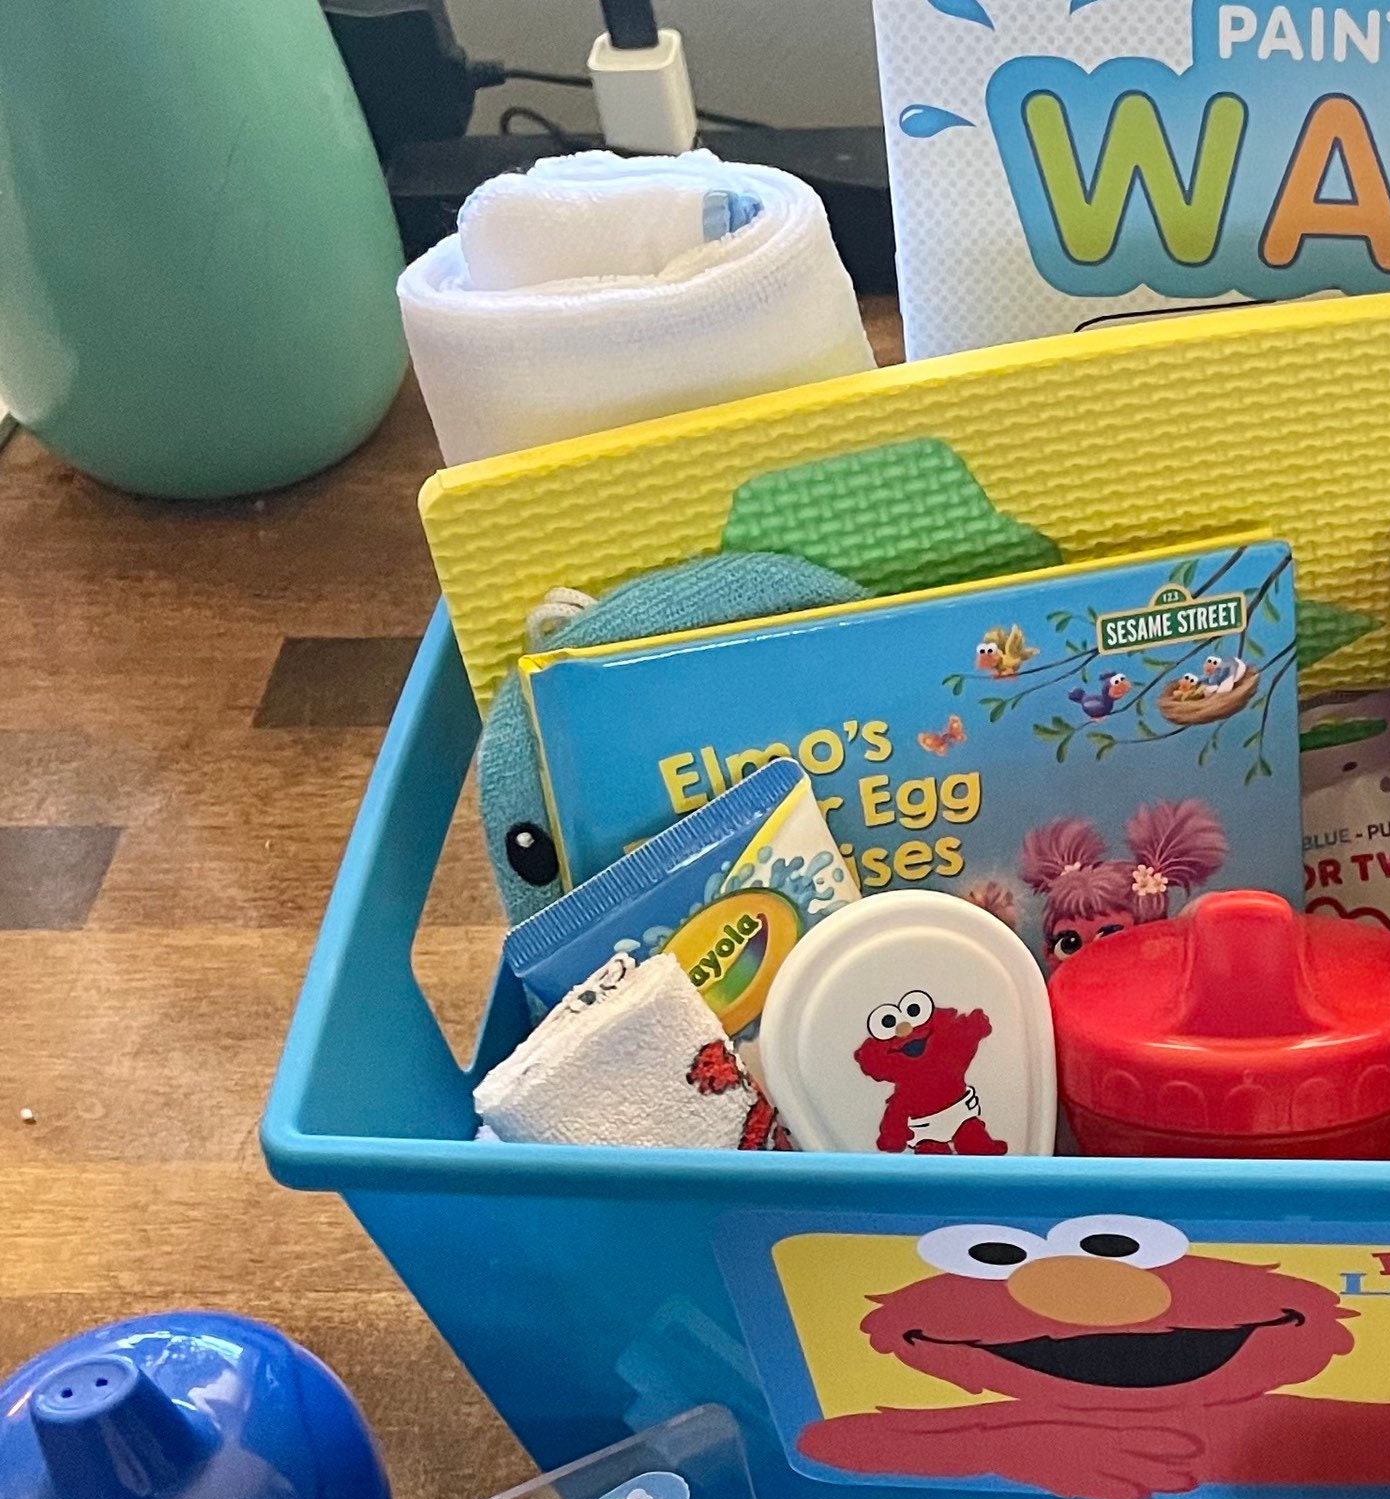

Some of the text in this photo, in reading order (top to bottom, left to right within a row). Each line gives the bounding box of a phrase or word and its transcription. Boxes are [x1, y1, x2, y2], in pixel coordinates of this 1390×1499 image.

[1106, 602, 1238, 646] SESAME STREET
[859, 771, 981, 829] Egg
[1302, 828, 1351, 851] BLUE
[689, 914, 760, 987] ayola
